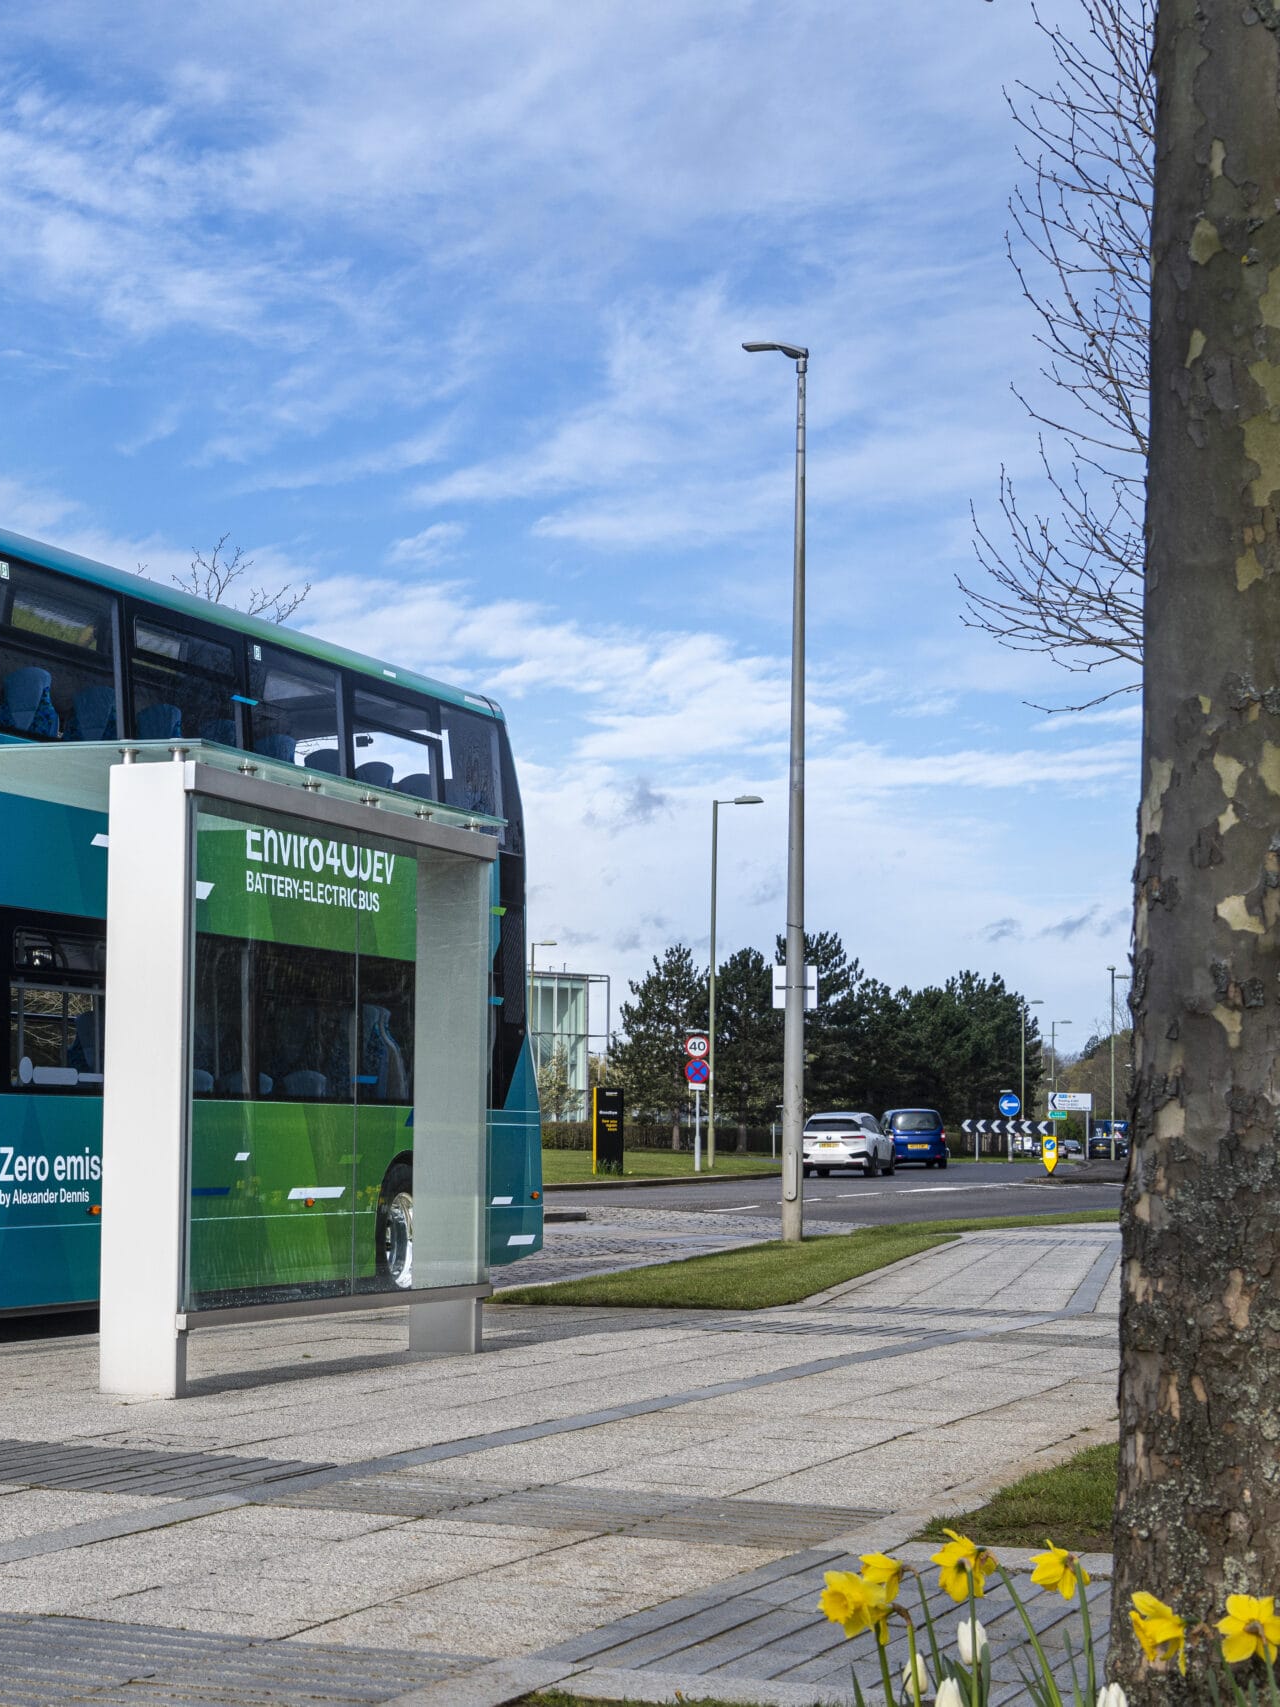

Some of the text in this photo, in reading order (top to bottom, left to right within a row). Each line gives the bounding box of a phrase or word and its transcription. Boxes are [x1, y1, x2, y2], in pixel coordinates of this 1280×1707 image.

[246, 870, 380, 912] BATTERY-ELECTRIC BUS
[689, 1041, 706, 1051] 40
[0, 1146, 103, 1181] Zero emis
[0, 1187, 90, 1208] by Alexander Dennis
